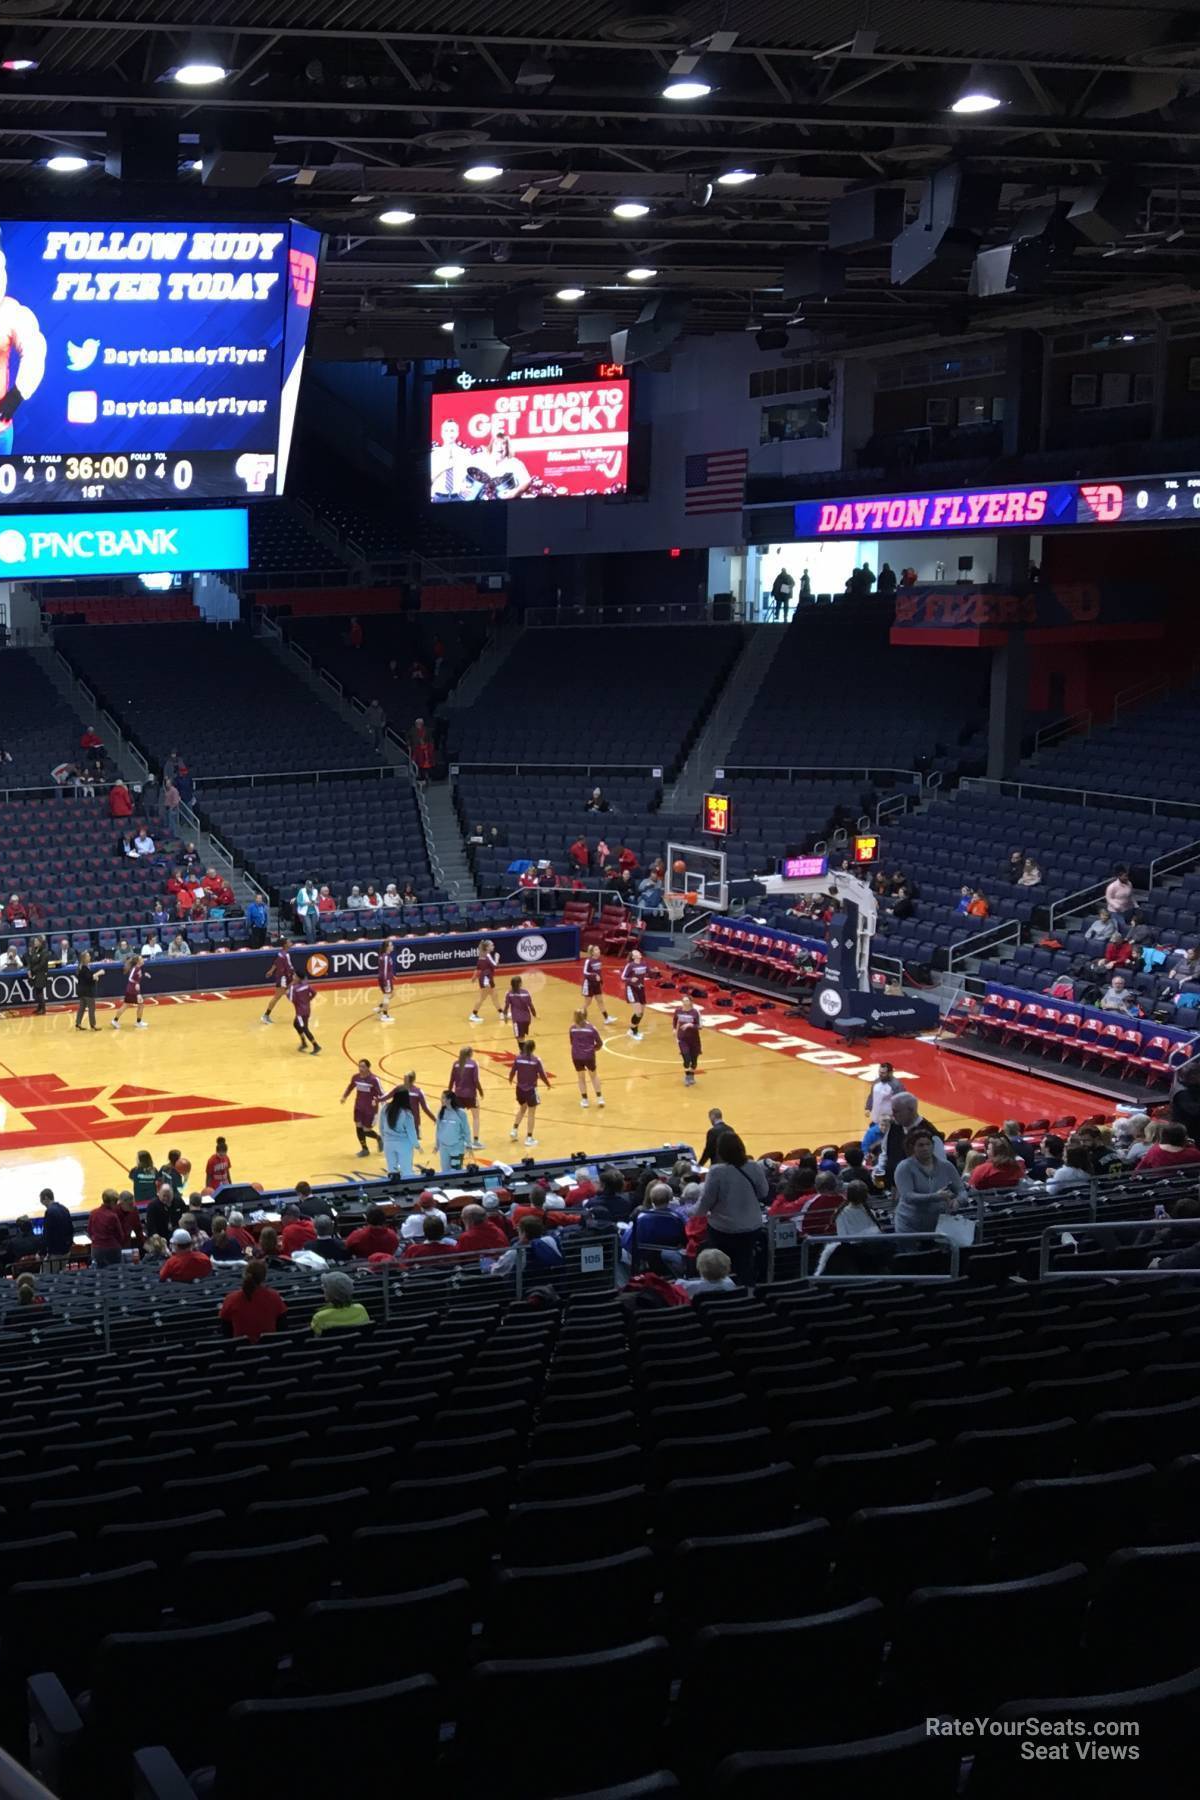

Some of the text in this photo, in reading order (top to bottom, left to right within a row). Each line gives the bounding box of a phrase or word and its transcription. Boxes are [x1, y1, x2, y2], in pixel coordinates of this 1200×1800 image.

[42, 231, 284, 260] FOLLOW RUDY
[52, 272, 279, 301] FLYER TODAY
[103, 346, 267, 367] DaytonRudyFlyer
[524, 365, 563, 380] Health
[102, 397, 267, 418] DaytonRudyFlyer
[495, 388, 624, 413] GET READY TO
[468, 404, 624, 438] GET LUCKY
[23, 466, 35, 482] 4
[45, 466, 56, 482] 0
[65, 456, 128, 480] 36:00
[134, 464, 146, 479] 0
[154, 463, 166, 479] 4
[173, 460, 193, 490] 0
[818, 490, 1048, 533] DAYTON FLYERS
[1136, 490, 1149, 509] 0
[1167, 494, 1177, 510] 4
[29, 528, 179, 559] PNC BANK
[331, 951, 379, 973] PNC
[419, 950, 452, 962] Premier
